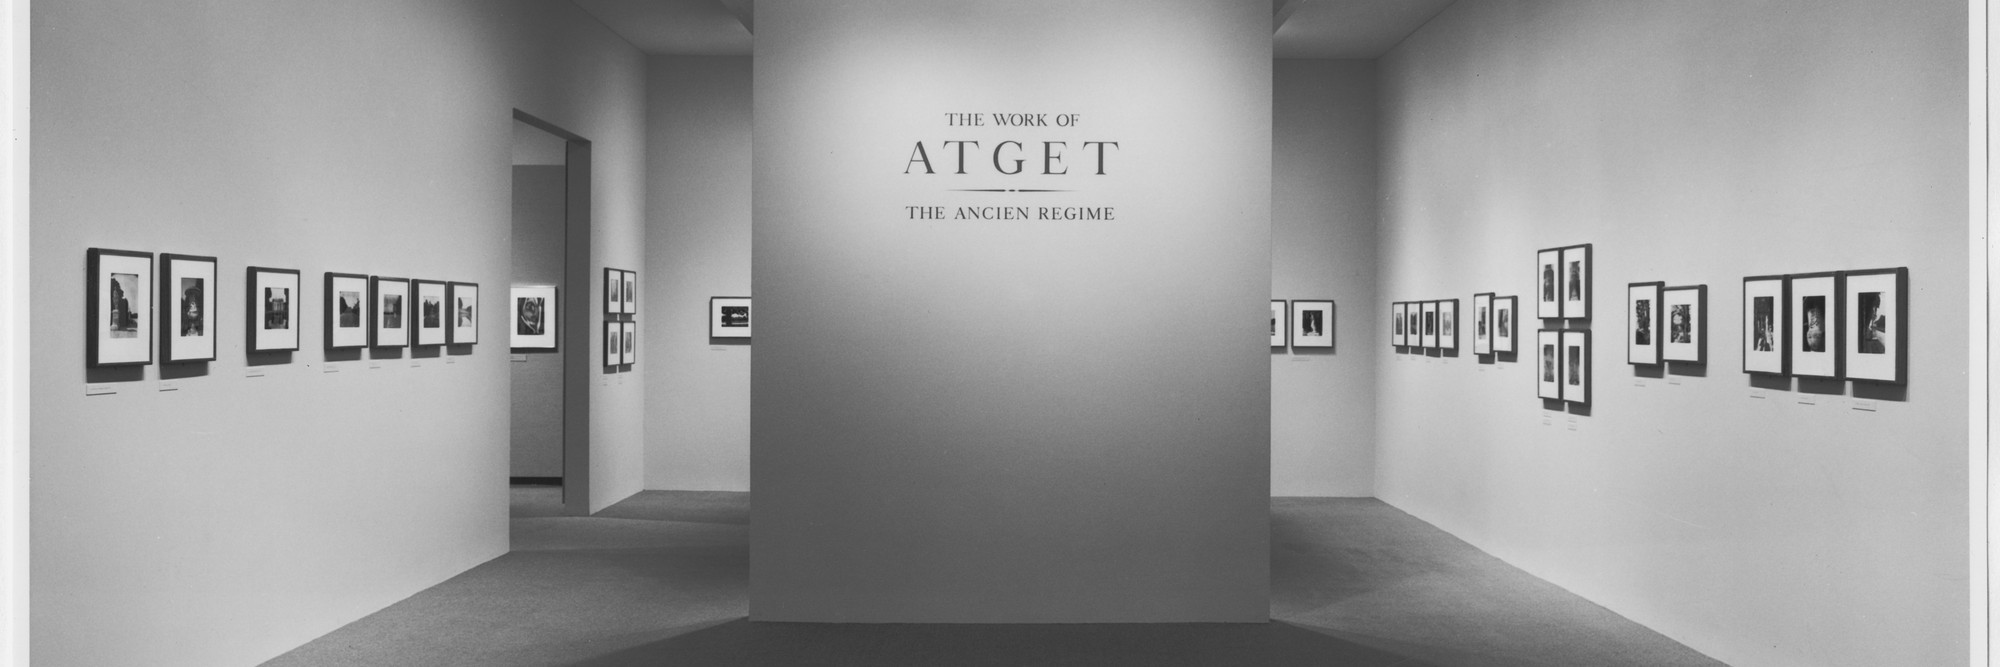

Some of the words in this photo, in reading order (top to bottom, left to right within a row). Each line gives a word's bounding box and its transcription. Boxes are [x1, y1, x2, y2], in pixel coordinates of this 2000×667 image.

[944, 113, 984, 126] THE
[992, 113, 1048, 127] WORK
[1056, 113, 1080, 127] OF
[903, 140, 1120, 175] ATGET
[905, 206, 945, 220] THE
[954, 206, 1029, 220] ANCIEN
[1038, 206, 1115, 220] REGIME
